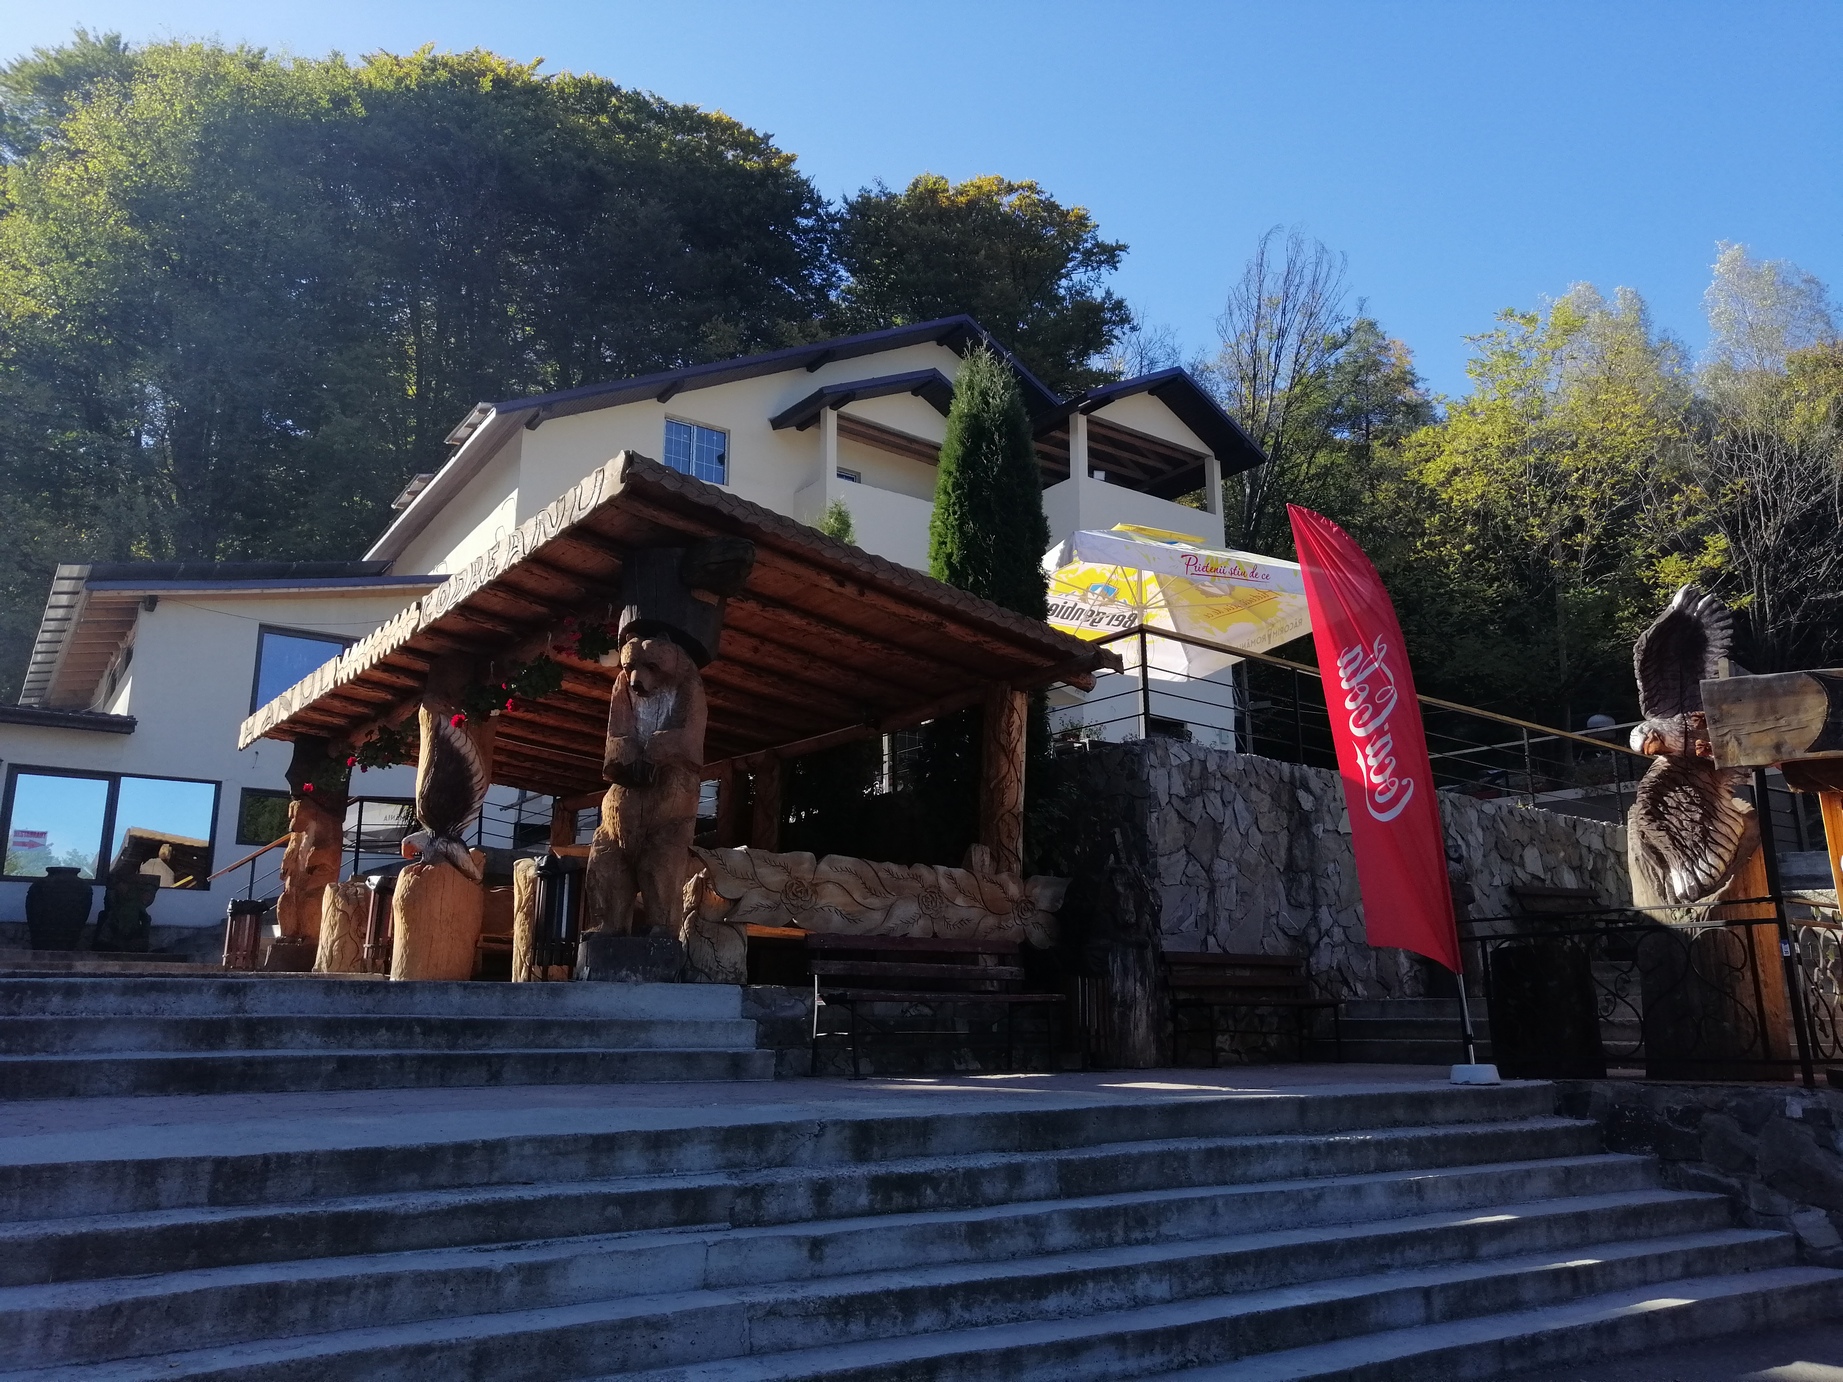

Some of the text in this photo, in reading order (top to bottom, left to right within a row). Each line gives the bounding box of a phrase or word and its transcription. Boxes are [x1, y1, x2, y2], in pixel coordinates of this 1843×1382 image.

[242, 468, 605, 748] HANUL CODREANU
[1181, 554, 1227, 575] Prietenii
[1249, 564, 1260, 578] de
[1261, 572, 1271, 580] ce
